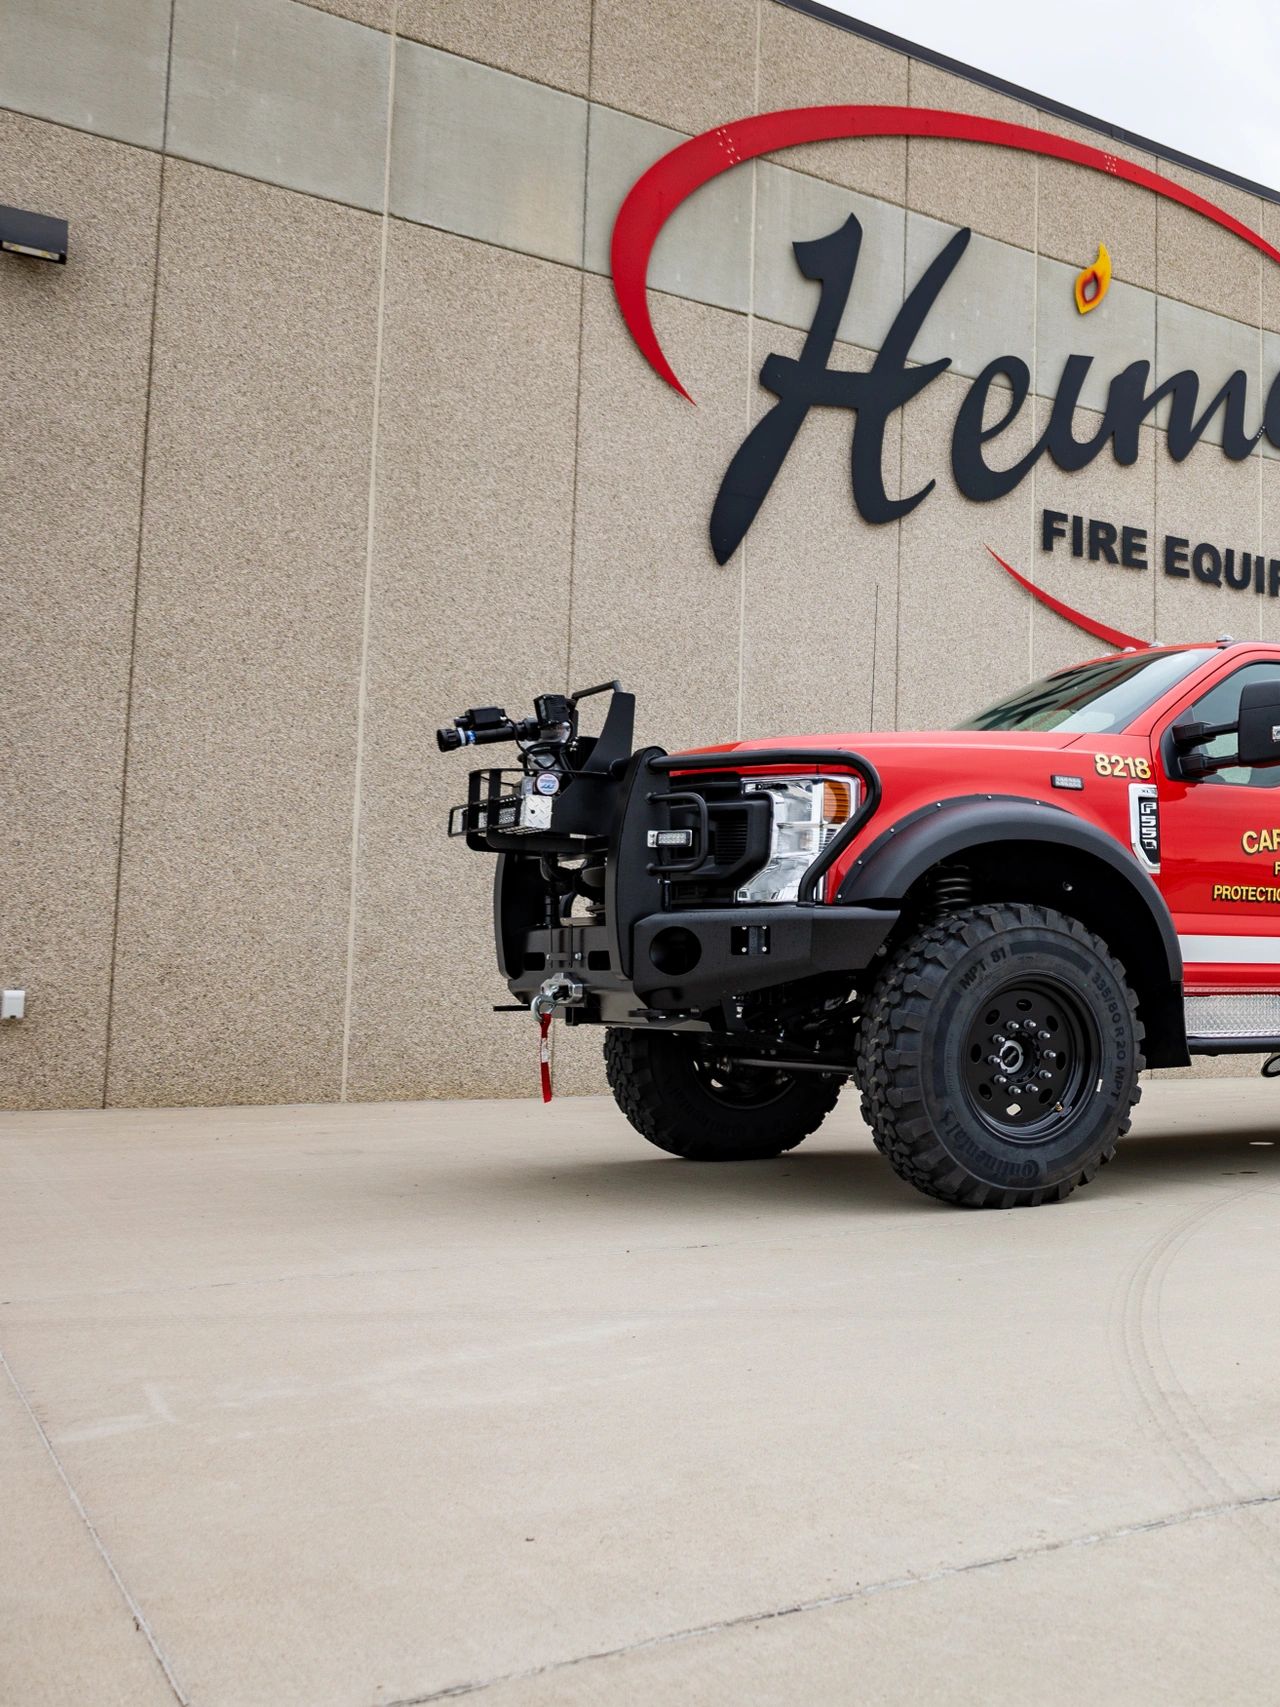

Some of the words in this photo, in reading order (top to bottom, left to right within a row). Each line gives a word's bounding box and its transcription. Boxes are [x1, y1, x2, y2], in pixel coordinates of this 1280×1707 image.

[1042, 508, 1148, 570] FIRE
[1094, 753, 1152, 780] 8218
[959, 958, 987, 990] MPT
[990, 947, 1007, 963] 81
[1092, 971, 1122, 1024] 335/80
